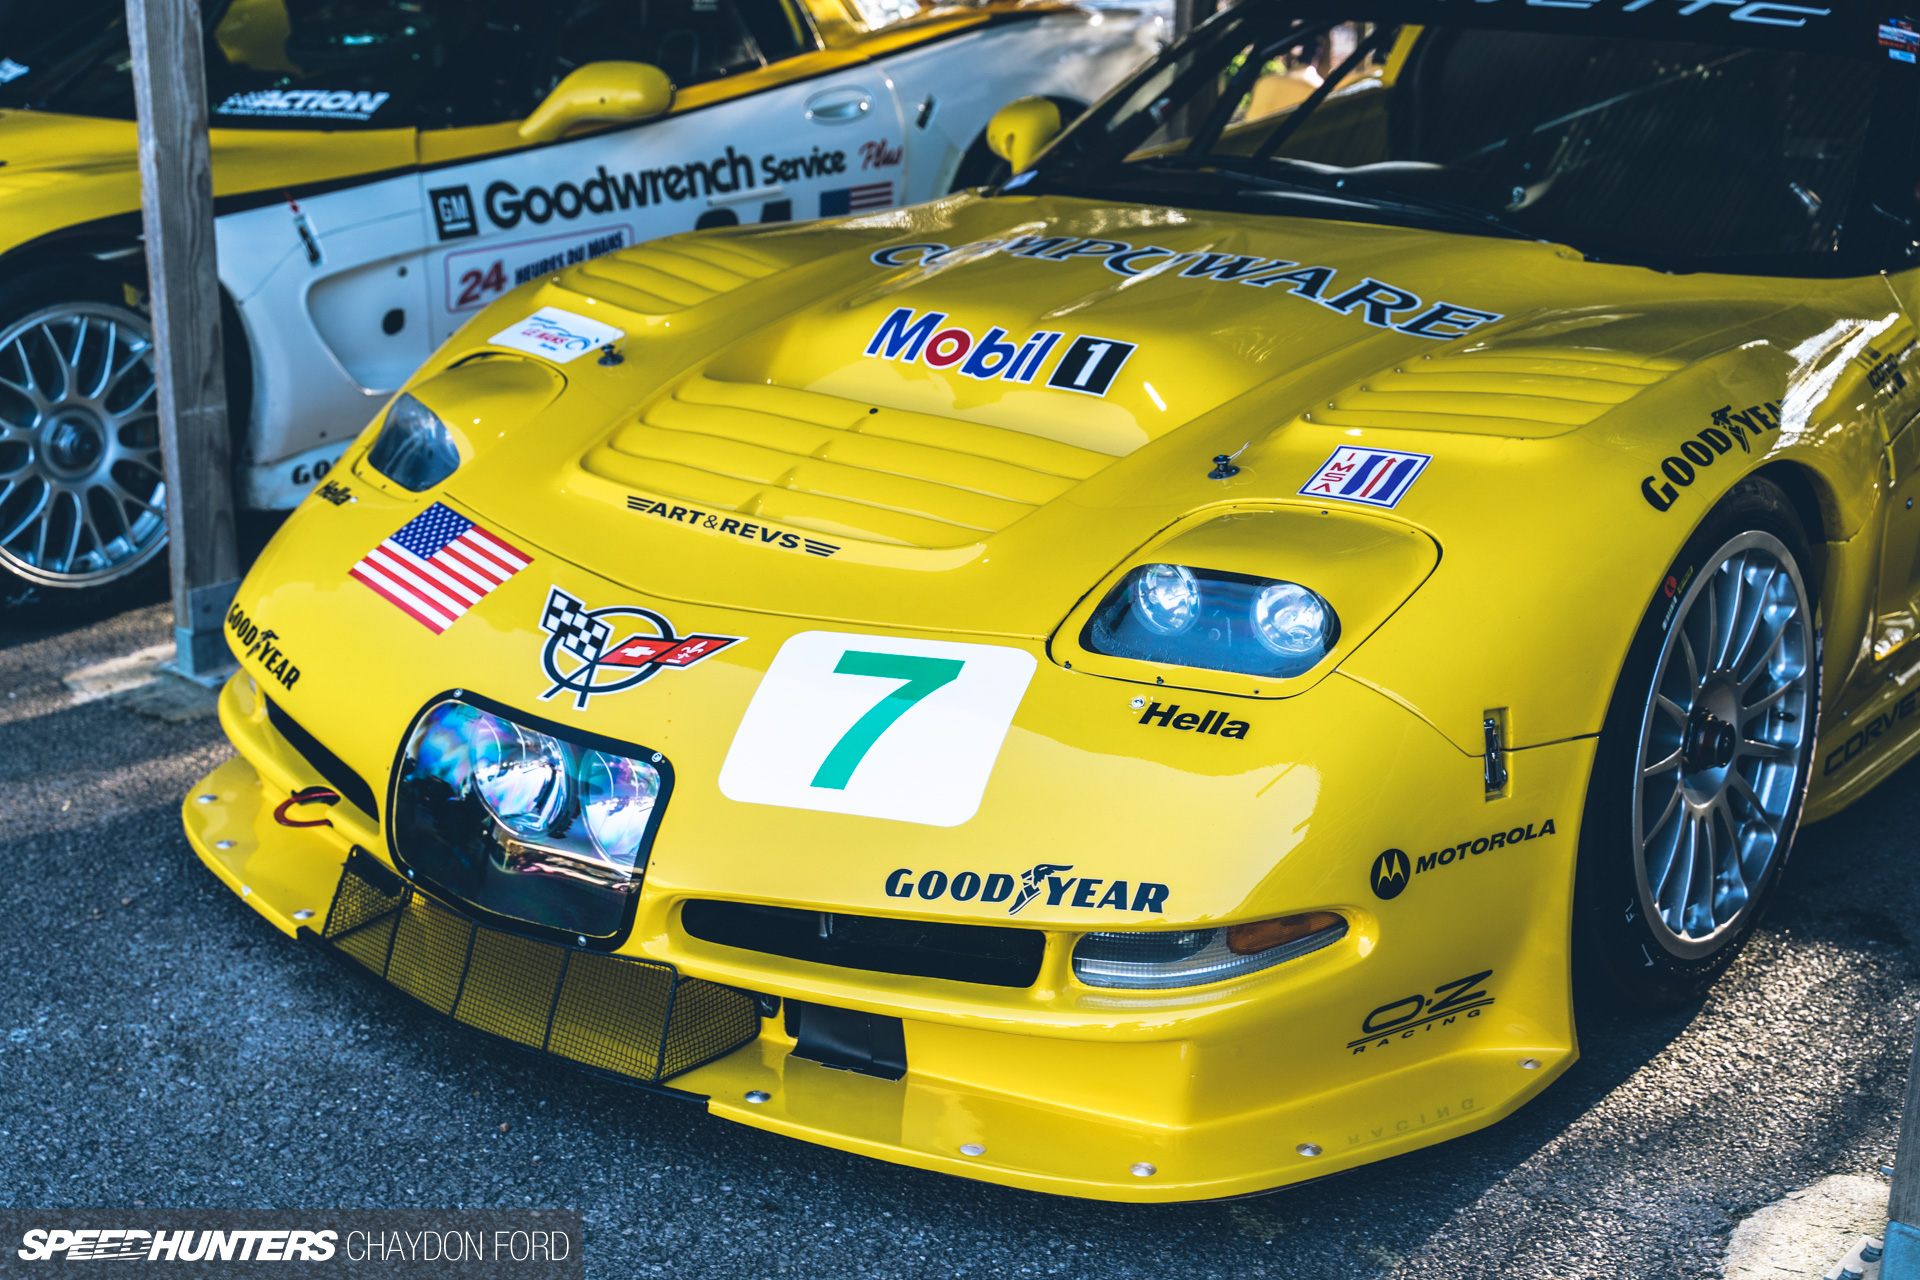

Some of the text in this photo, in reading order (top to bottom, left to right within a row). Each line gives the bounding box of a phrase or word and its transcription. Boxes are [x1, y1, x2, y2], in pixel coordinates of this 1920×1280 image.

[252, 90, 390, 113] ACTION
[484, 145, 755, 230] Goodwrench
[761, 147, 846, 186] Service
[859, 139, 903, 171] Plus
[457, 261, 507, 306] 24
[587, 231, 624, 258] MANS
[870, 235, 1504, 340] COMPUWARE
[863, 307, 1065, 384] Mobil
[315, 480, 352, 506] Hella
[1312, 453, 1356, 493] IMSA
[810, 650, 966, 790] 7
[1138, 702, 1250, 740] Hella
[1823, 686, 1920, 776] CORVE
[1415, 819, 1556, 874] MOTOROLA
[1353, 1009, 1480, 1055] RACING
